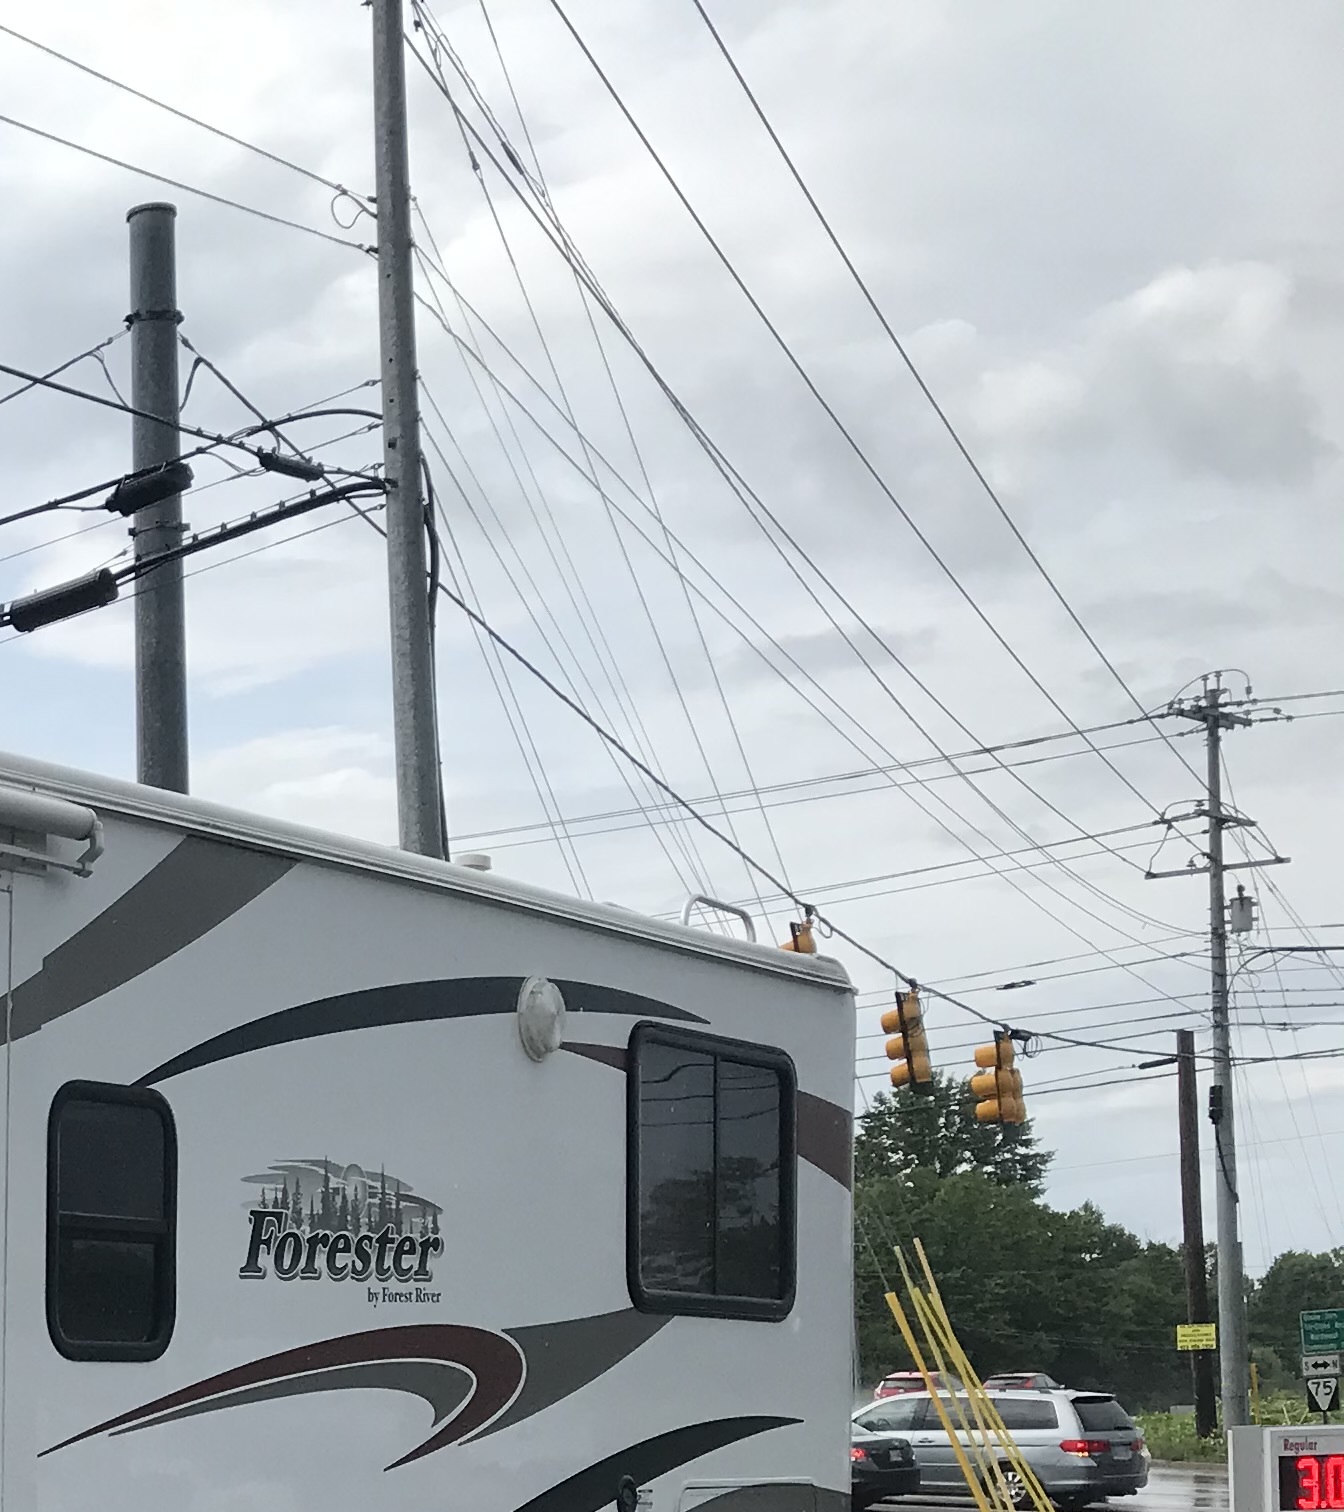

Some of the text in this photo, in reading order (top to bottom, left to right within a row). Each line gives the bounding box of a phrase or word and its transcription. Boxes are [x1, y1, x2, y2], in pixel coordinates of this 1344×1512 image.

[238, 1209, 444, 1282] Forester
[367, 1286, 442, 1308] by Forest River
[1311, 1380, 1333, 1396] 75
[1283, 1436, 1318, 1455] Regular
